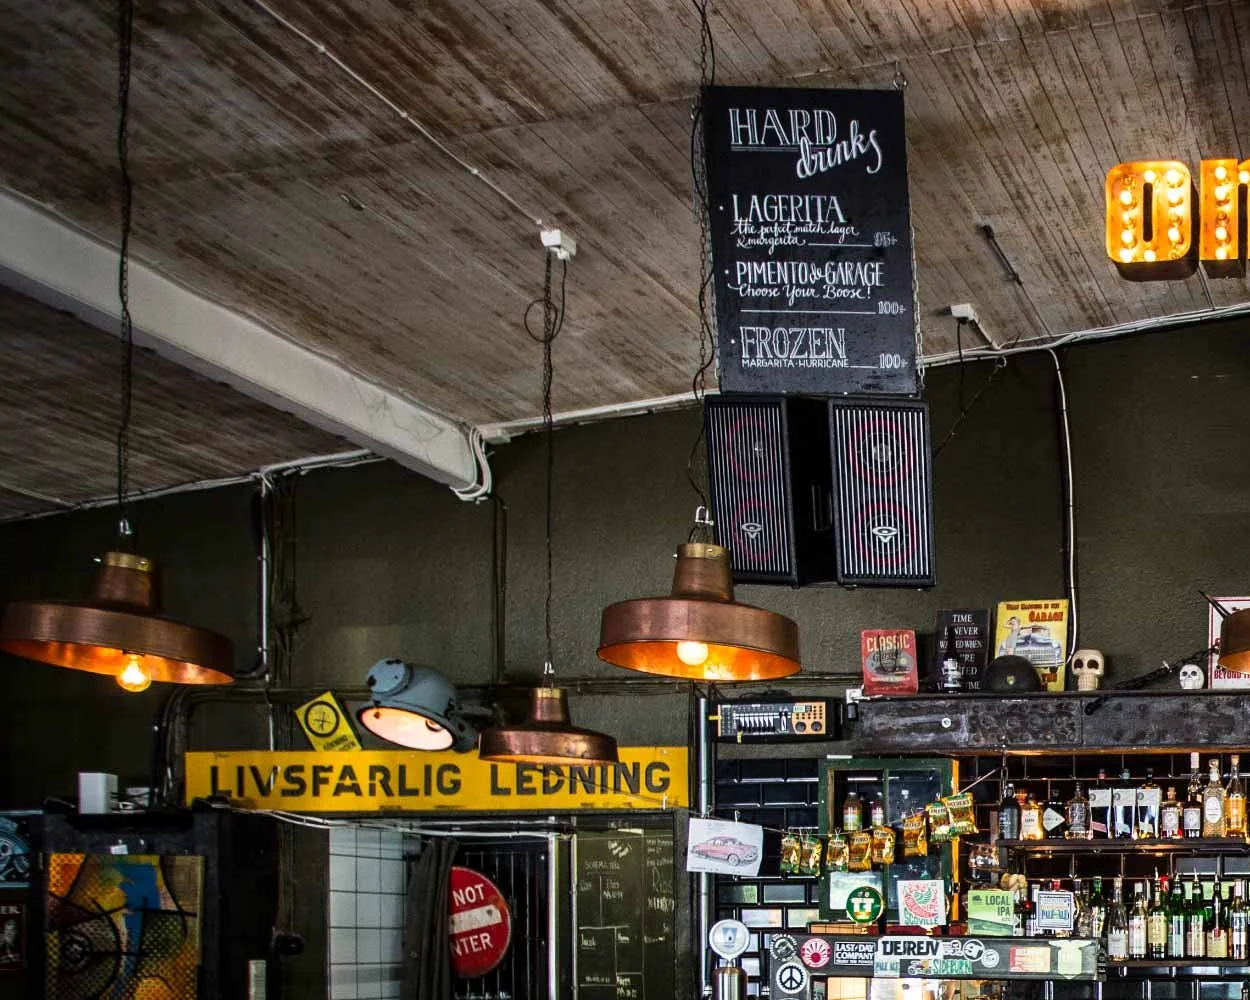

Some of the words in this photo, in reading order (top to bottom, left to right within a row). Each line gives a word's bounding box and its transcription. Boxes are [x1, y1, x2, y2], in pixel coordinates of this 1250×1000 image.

[728, 108, 837, 146] HARD
[796, 120, 883, 179] drinks
[732, 194, 847, 223] LAGERITA
[827, 221, 860, 244] lager
[736, 261, 808, 285] PIMENTO
[825, 261, 885, 287] GARAGE
[782, 285, 820, 306] Your
[739, 327, 847, 359] FROZEN
[866, 634, 910, 652] CLASSIC
[210, 764, 462, 798] LIVSFARLIG
[490, 761, 671, 796] LEDNING
[453, 883, 485, 906] NOT
[985, 895, 1011, 906] LOCAL
[997, 907, 1011, 917] IPA
[449, 933, 493, 957] NTER
[836, 943, 854, 952] LAST
[859, 943, 874, 952] DAY
[836, 952, 874, 960] COMPANY
